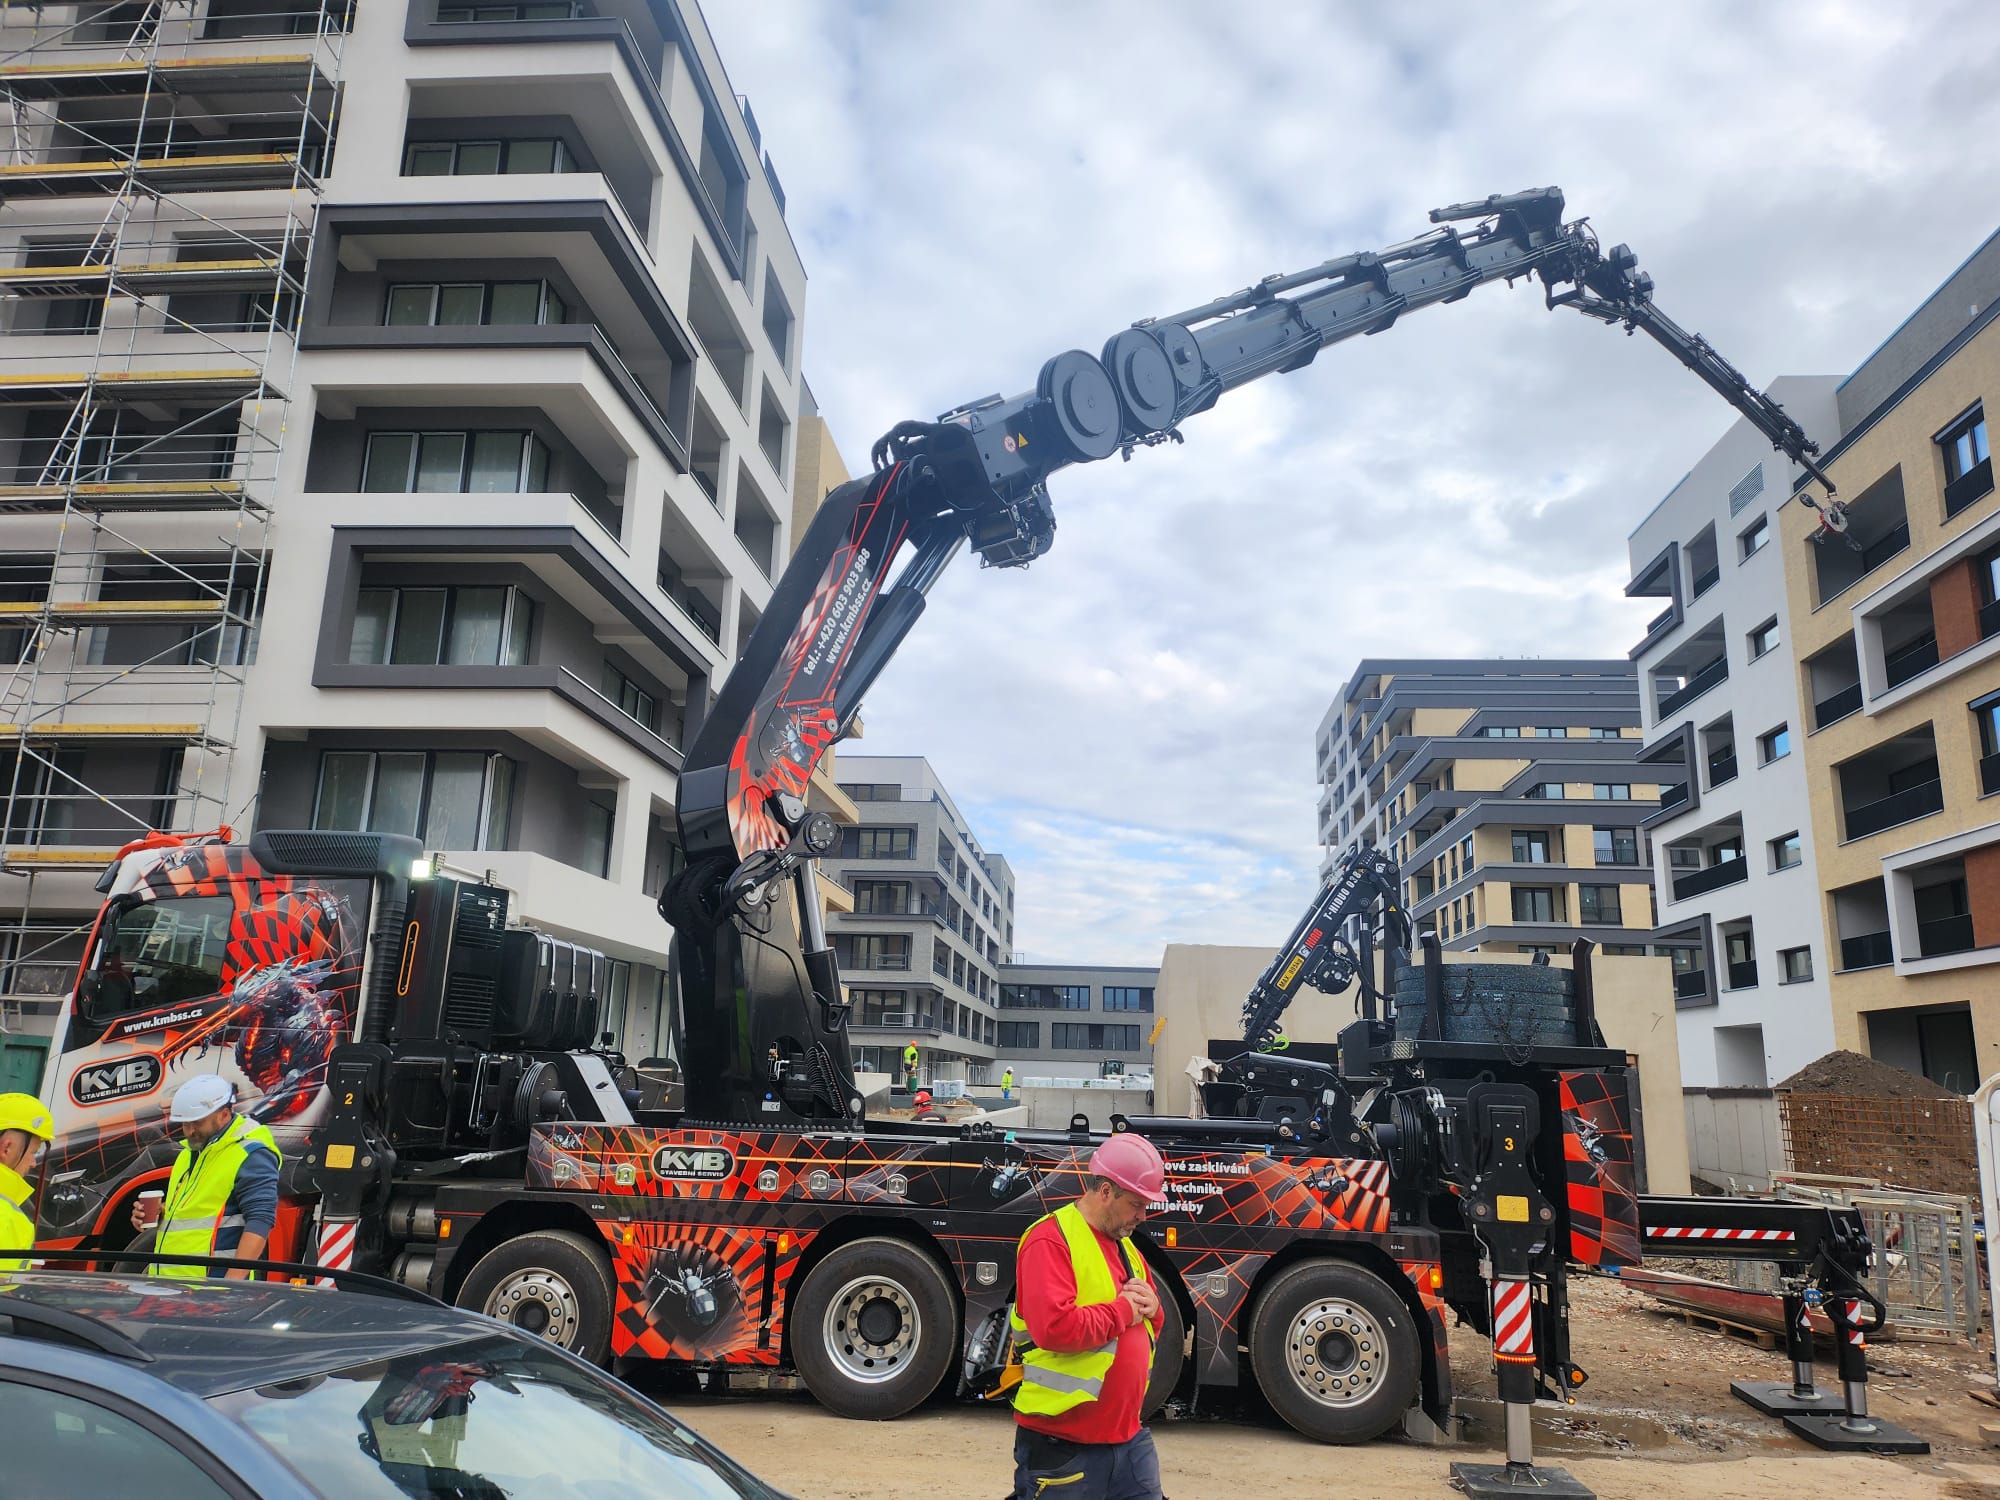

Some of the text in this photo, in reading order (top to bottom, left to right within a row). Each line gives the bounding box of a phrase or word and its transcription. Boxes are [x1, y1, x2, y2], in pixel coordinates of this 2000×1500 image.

[817, 617, 837, 650] +420
[832, 594, 848, 619] 603
[843, 570, 859, 596] 903
[854, 547, 871, 573] 888
[825, 577, 873, 664] www.kmbss.cz
[123, 1008, 203, 1034] www.kmbss.cz
[80, 1060, 153, 1094] KMB
[121, 1081, 152, 1092] SERVIS
[344, 1092, 354, 1105] 2
[1504, 1137, 1514, 1151] 3
[660, 1150, 726, 1171] KMB
[1188, 1161, 1250, 1175] zasklívání
[1170, 1181, 1224, 1195] technika
